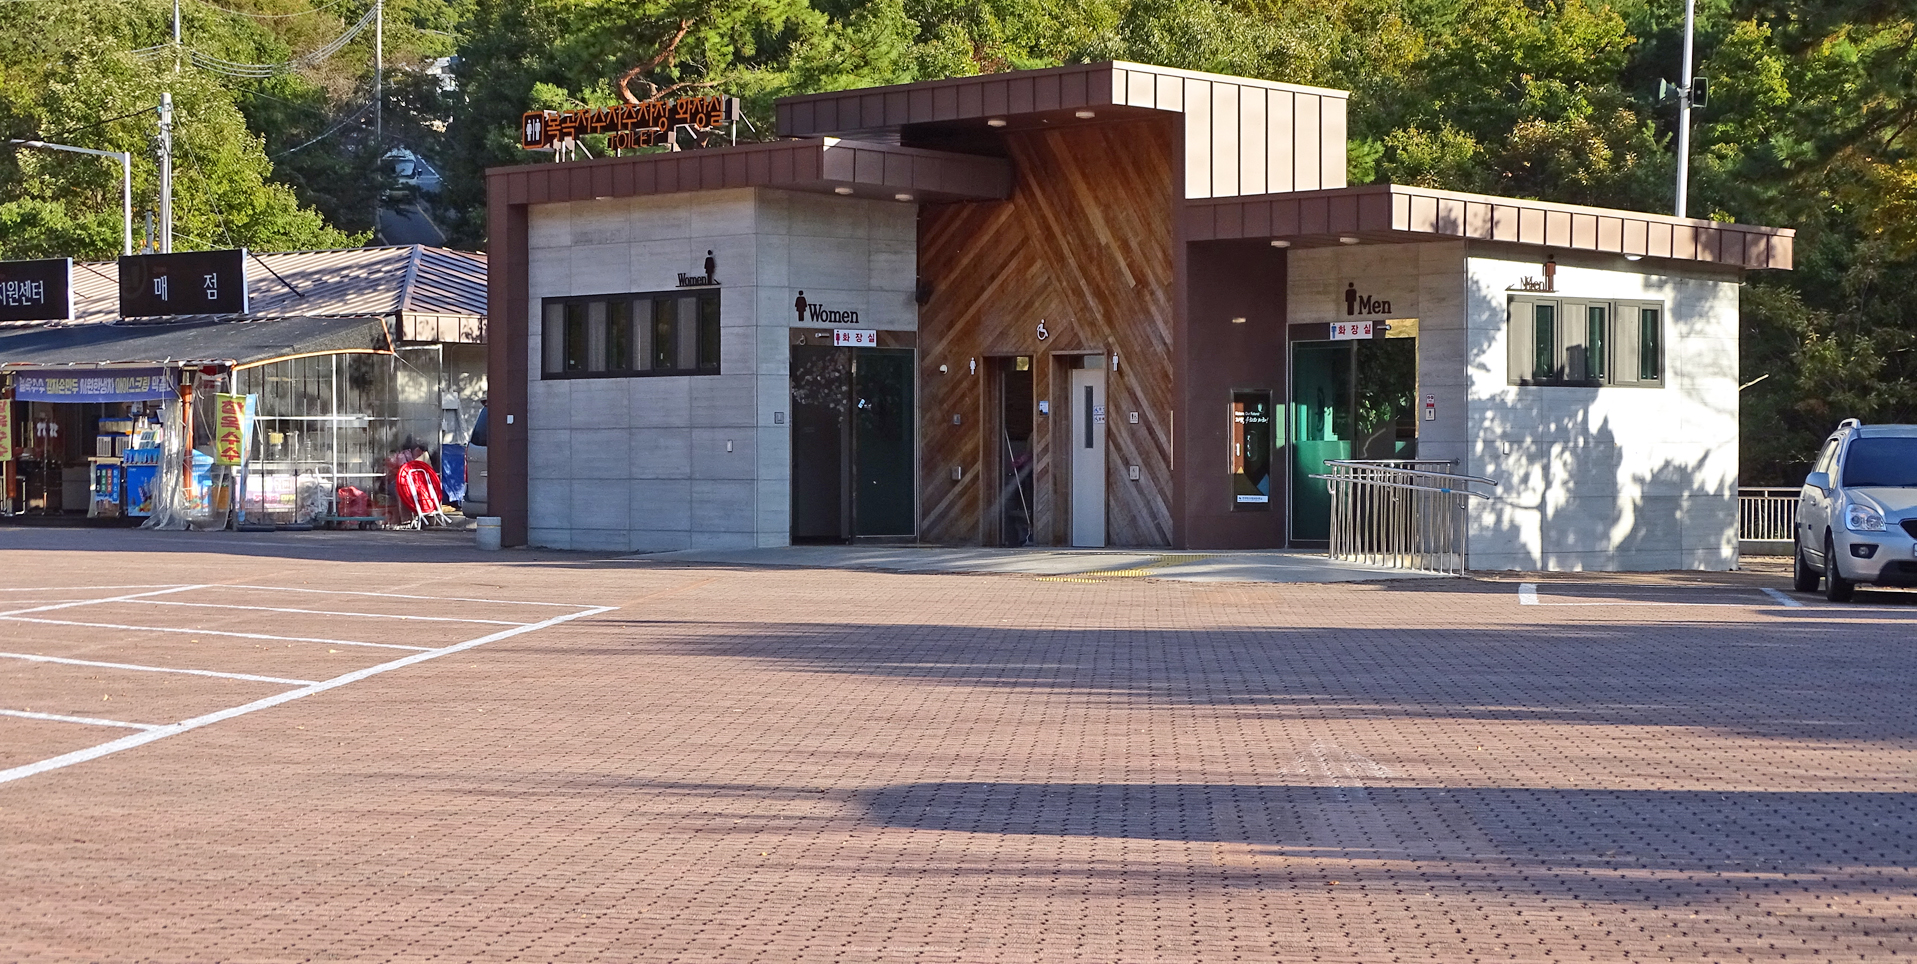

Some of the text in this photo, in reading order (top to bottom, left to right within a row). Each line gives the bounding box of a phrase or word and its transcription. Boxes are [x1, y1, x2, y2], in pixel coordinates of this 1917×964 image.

[546, 94, 724, 142] 복곡저수지주차장 화장실
[608, 129, 658, 150] TOILET
[677, 272, 707, 287] Women
[808, 303, 860, 324] Women
[1358, 294, 1392, 315] Men
[115, 376, 151, 394] 아이스크림
